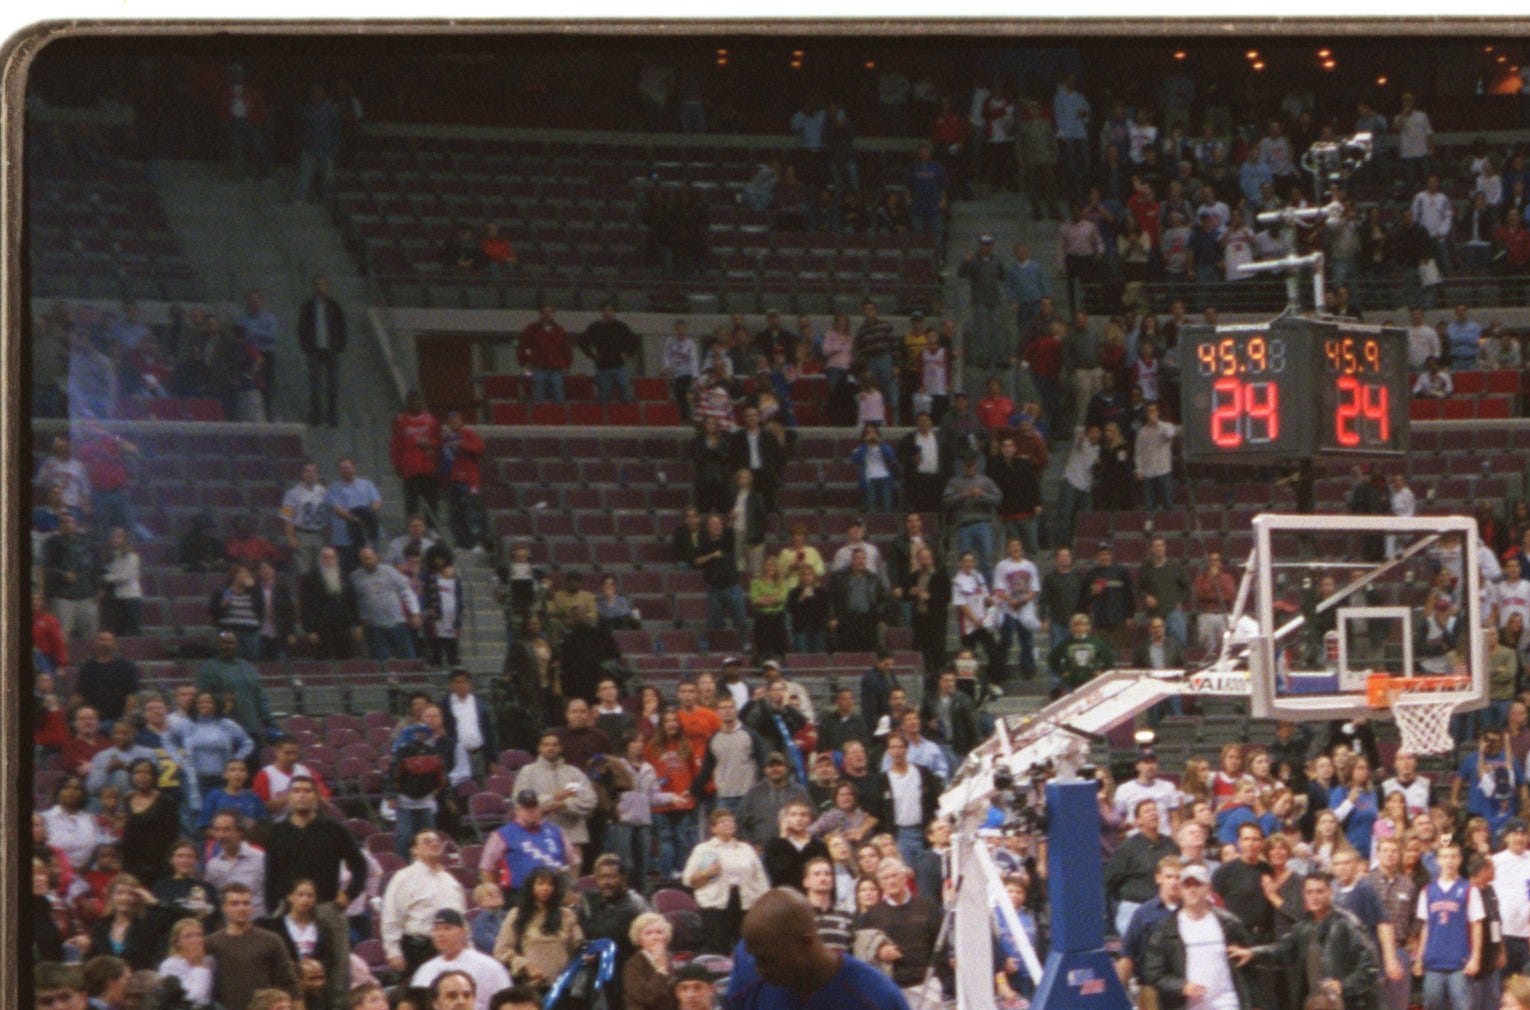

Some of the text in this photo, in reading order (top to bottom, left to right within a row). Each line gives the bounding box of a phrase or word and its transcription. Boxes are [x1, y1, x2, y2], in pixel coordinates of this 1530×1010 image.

[1197, 336, 1266, 375] 45.9
[1325, 338, 1380, 374] 45.9
[1211, 376, 1279, 447] 24
[1335, 376, 1390, 446] 24
